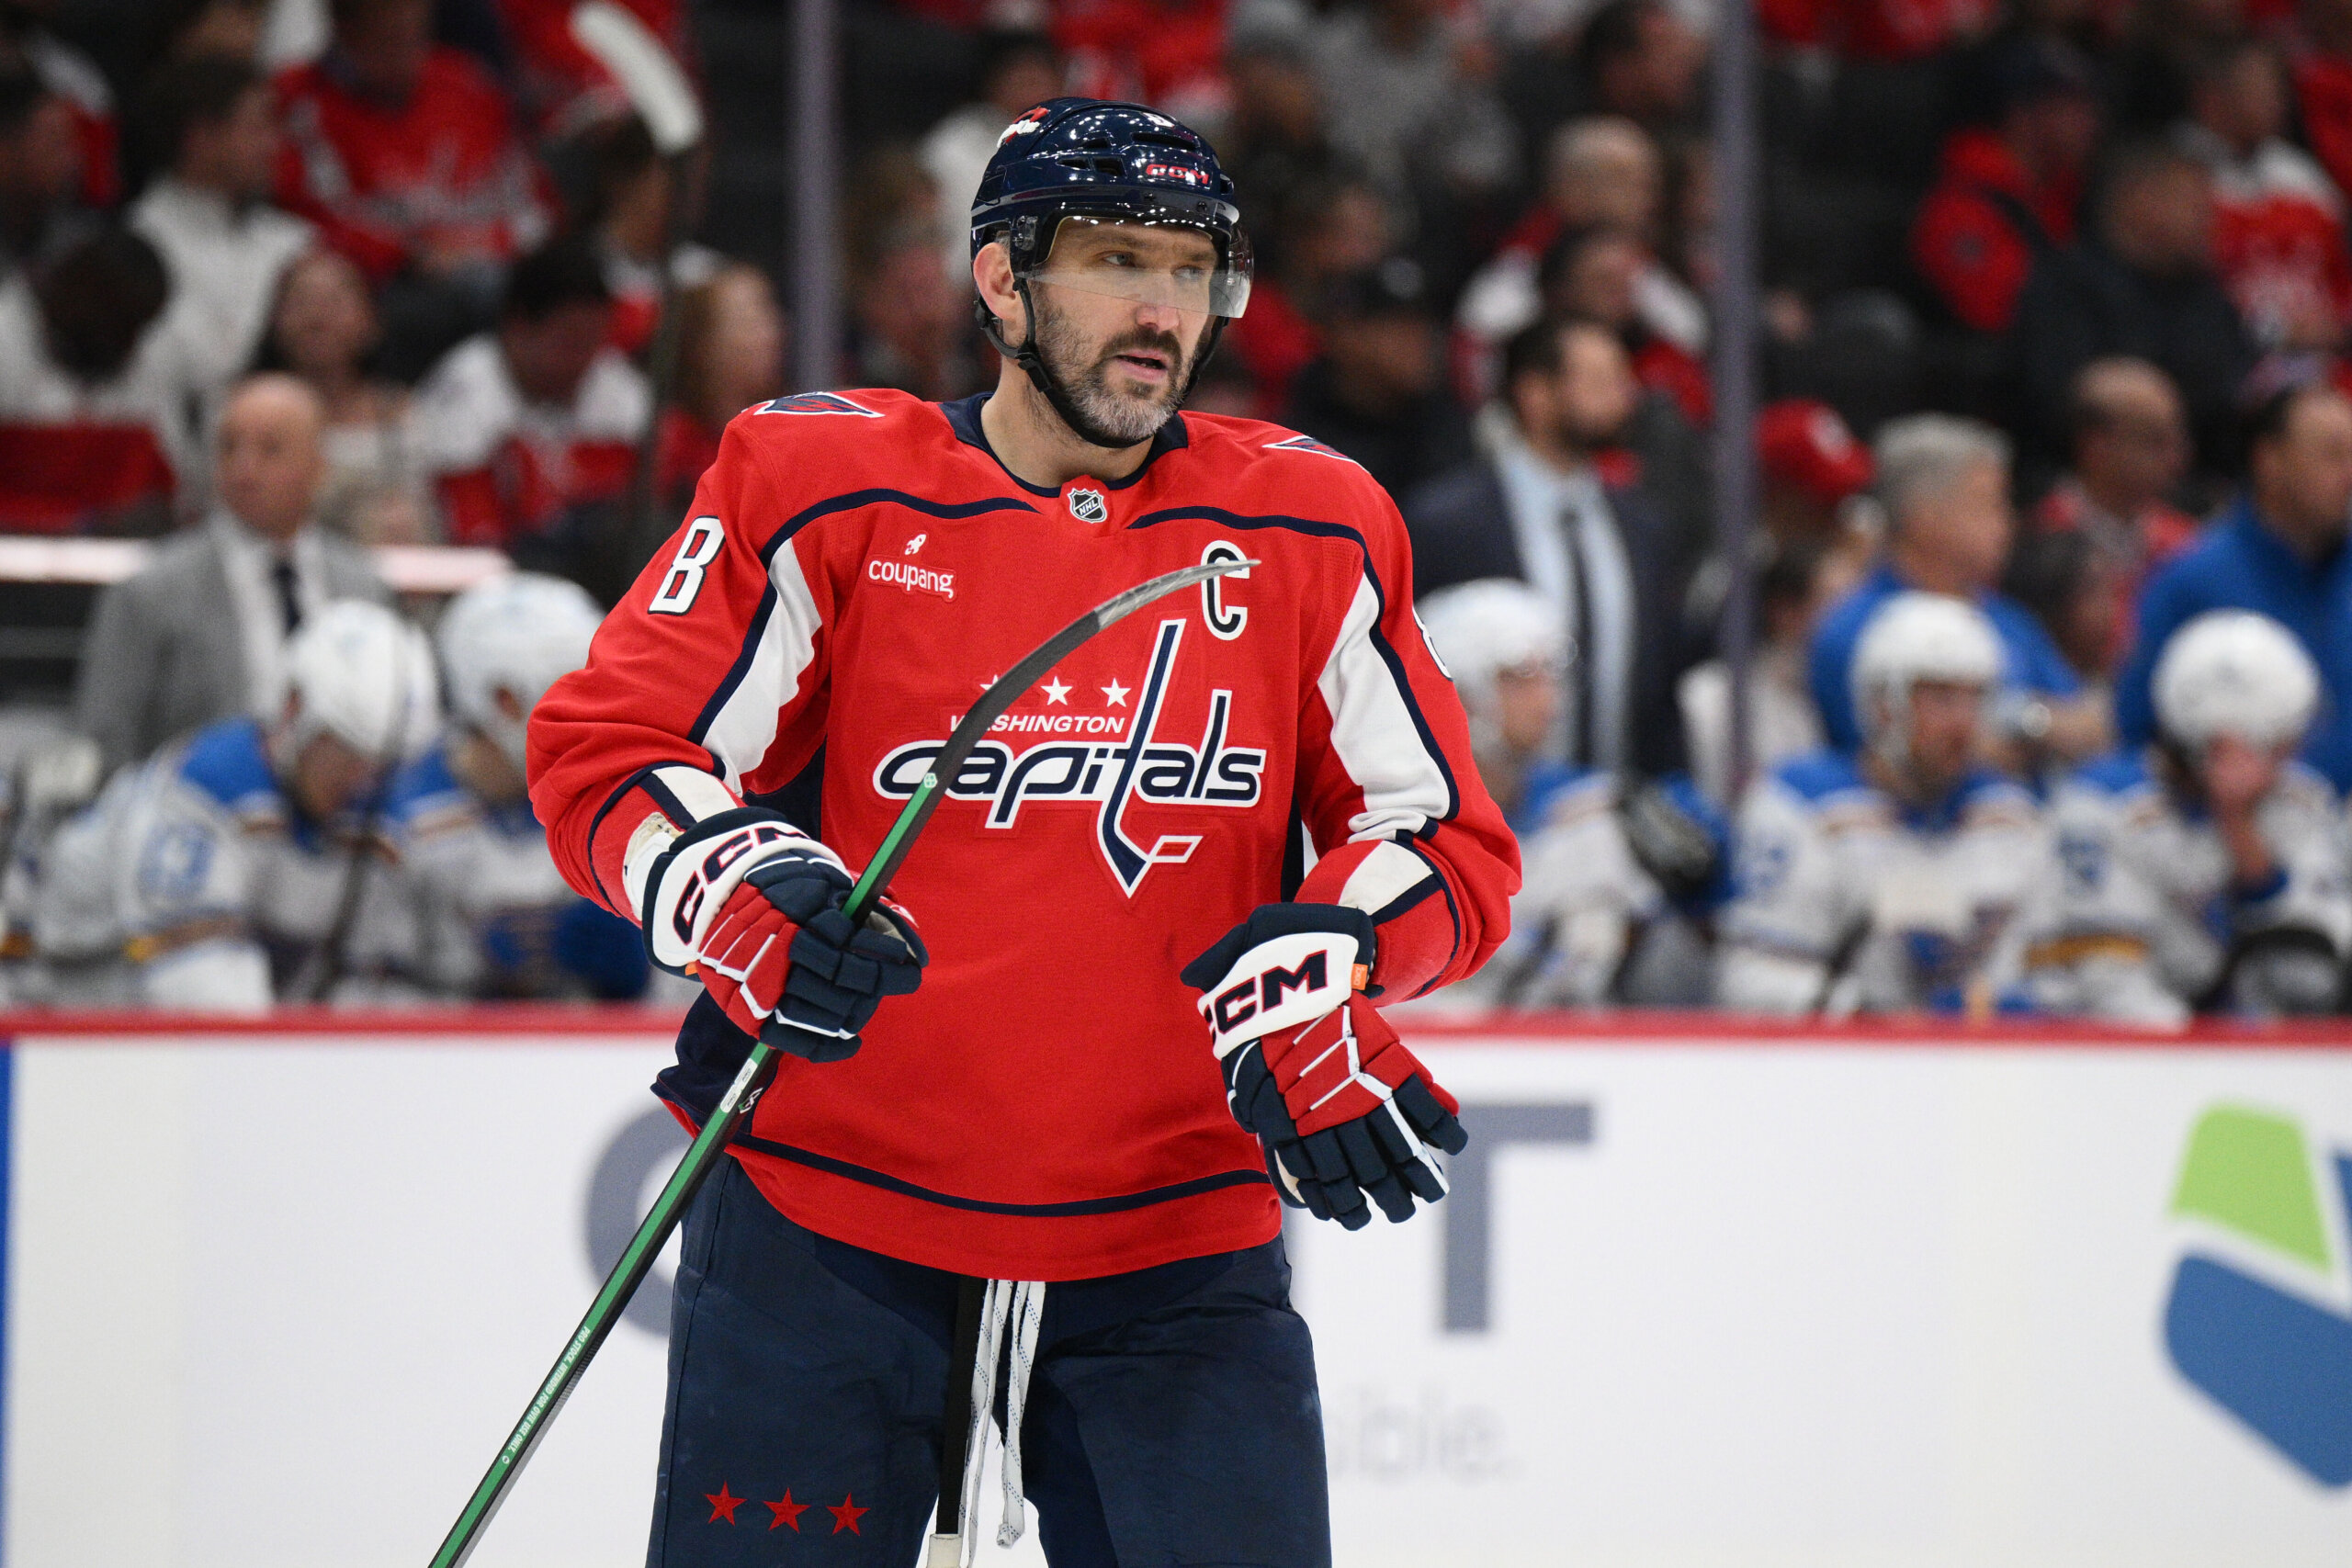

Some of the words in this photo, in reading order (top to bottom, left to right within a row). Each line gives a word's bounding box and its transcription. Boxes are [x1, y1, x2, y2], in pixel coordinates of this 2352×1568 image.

[1146, 164, 1210, 185] CCM
[1079, 499, 1099, 516] NHL
[647, 515, 727, 615] 8
[868, 560, 954, 599] coupang
[1200, 540, 1250, 640] C
[950, 715, 1125, 734] SHINGTON
[579, 1325, 591, 1342] PRO
[539, 1393, 549, 1409] FOR
[526, 1407, 541, 1425] OVIE
[519, 1421, 531, 1437] USE
